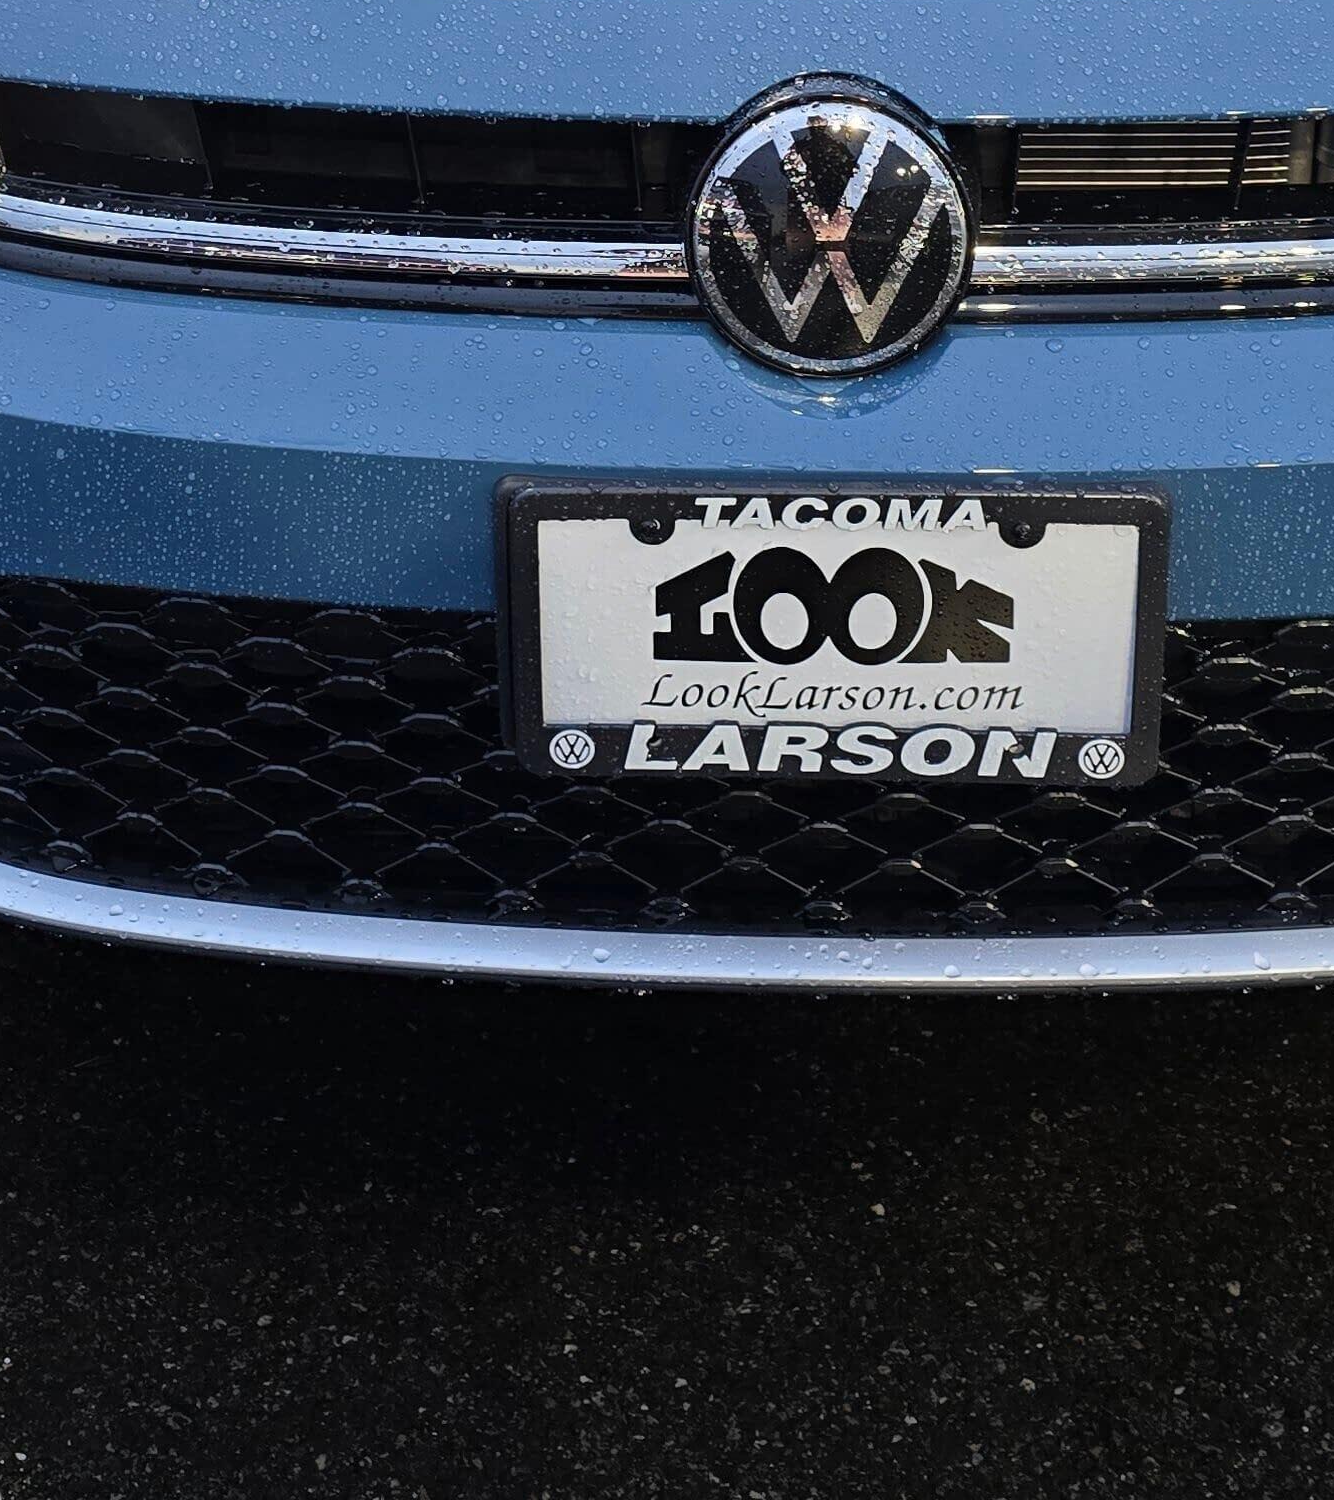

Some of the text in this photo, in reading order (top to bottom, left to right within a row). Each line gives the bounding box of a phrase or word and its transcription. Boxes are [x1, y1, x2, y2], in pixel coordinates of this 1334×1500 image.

[695, 496, 988, 533] TACOMA
[641, 670, 1025, 718] LookLarson.com
[623, 721, 1058, 779] LARSON
